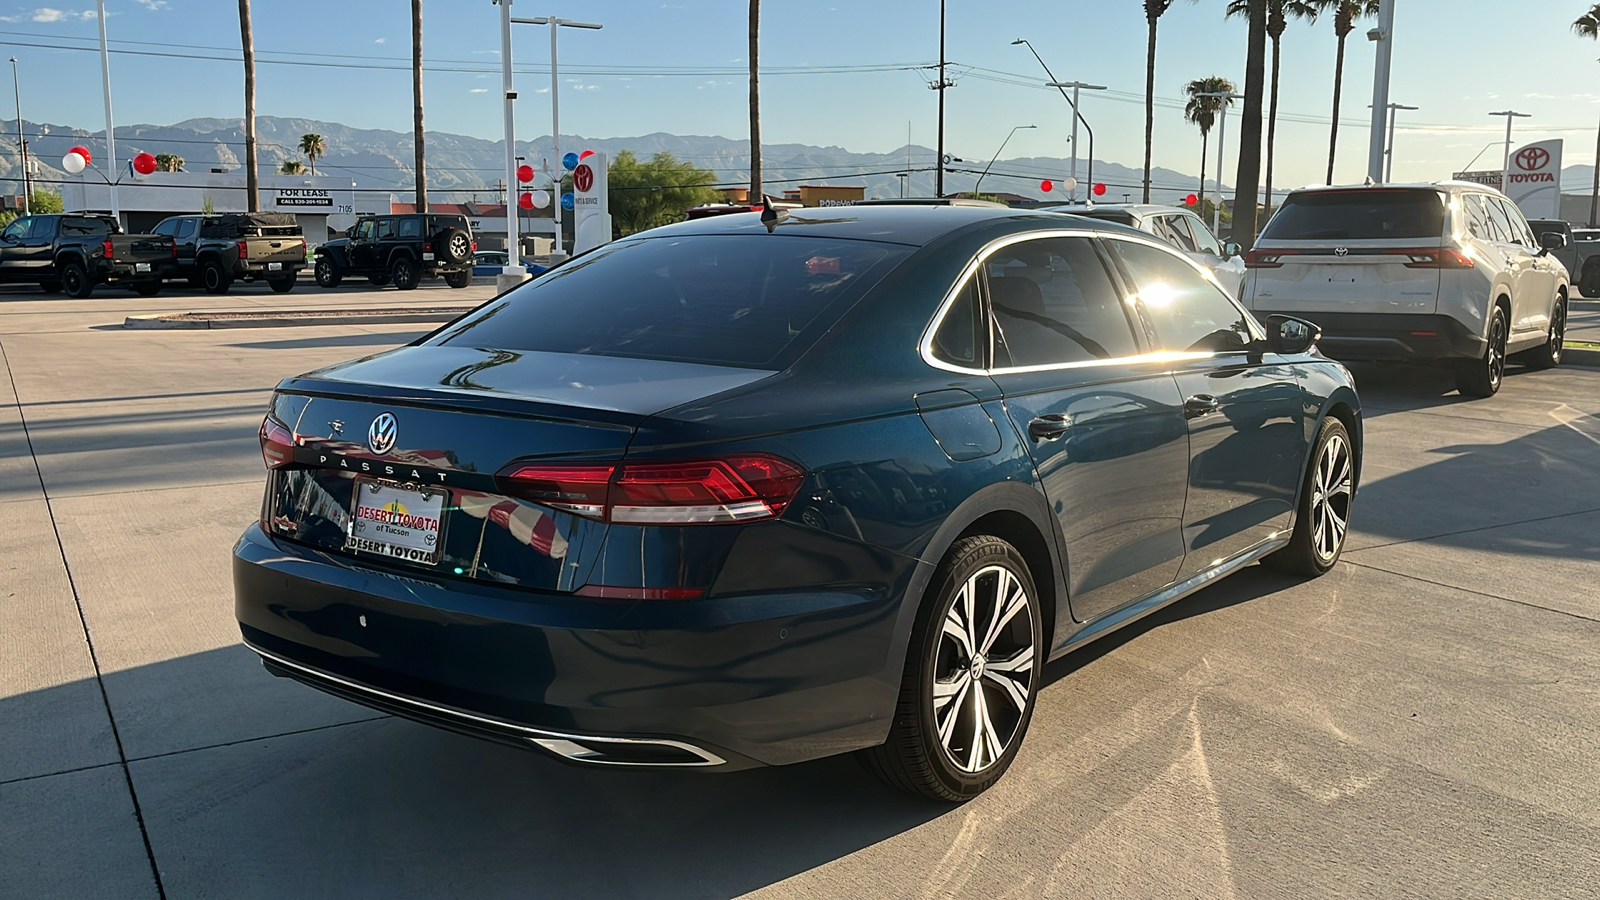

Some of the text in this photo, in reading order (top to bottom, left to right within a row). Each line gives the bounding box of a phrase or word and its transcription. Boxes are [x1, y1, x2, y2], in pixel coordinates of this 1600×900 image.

[1508, 172, 1554, 183] TOYOTA
[280, 189, 329, 197] FOR LEASE
[338, 205, 353, 213] 7105
[319, 455, 447, 482] PASSAT
[377, 478, 425, 492] TUCSON
[357, 505, 438, 532] DESERT TOYOTA
[376, 524, 410, 537] of Tucson
[350, 537, 432, 563] DESERT TOYOTA
